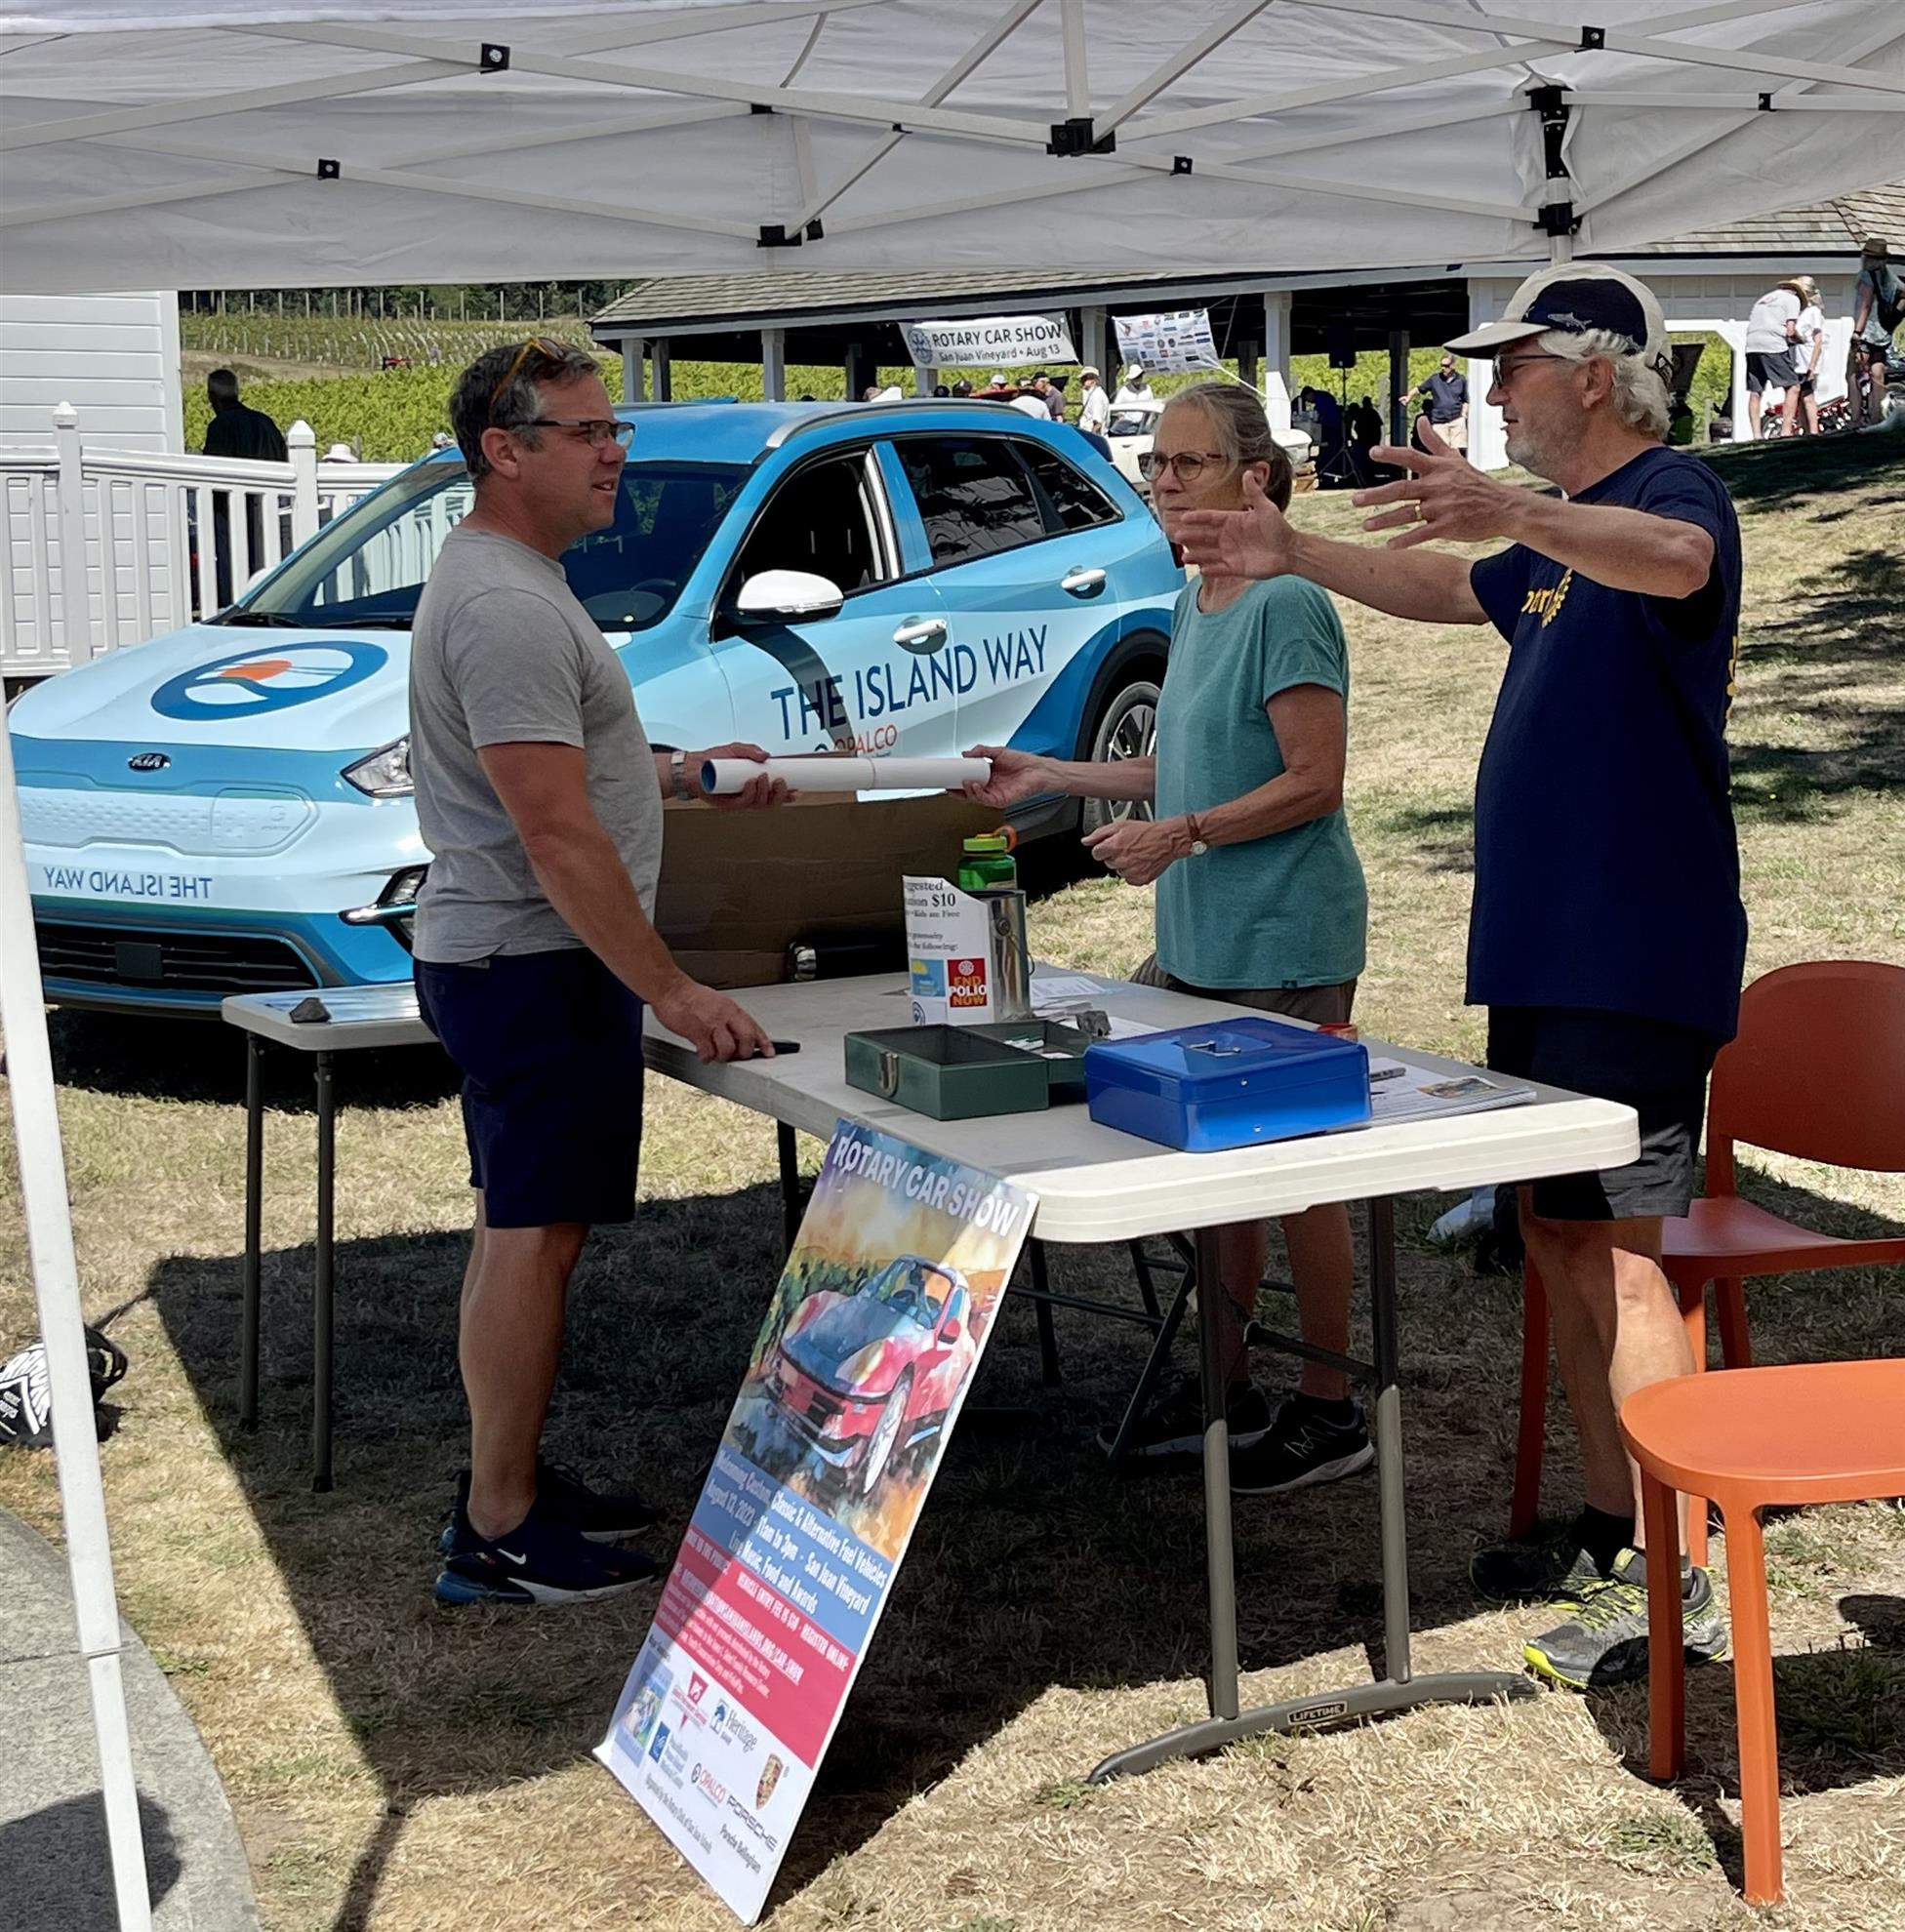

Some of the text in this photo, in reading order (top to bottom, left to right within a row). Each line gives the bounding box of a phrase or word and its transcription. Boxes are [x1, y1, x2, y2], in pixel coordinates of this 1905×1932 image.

[932, 324, 1061, 347] ROTARY CAR SHOW
[939, 343, 1060, 363] San Juan Vineyard Aug 13
[771, 624, 1047, 740] THE ISLAND WAY
[131, 753, 163, 768] KIA
[931, 893, 956, 907] $10
[949, 985, 988, 997] POLIO
[953, 976, 982, 986] END
[952, 995, 986, 1006] NOW
[832, 1135, 1020, 1237] ROTARY CAR SHOW
[799, 1511, 840, 1553] Alternative
[836, 1537, 859, 1565] Fuel
[854, 1549, 887, 1589] Vehicles
[760, 1555, 783, 1585] Food
[776, 1573, 795, 1594] and
[789, 1579, 818, 1614] Awards
[771, 1528, 783, 1550] to
[803, 1551, 821, 1578] San
[816, 1561, 837, 1590] Juan
[834, 1573, 871, 1615] Vineyard
[1293, 1705, 1341, 1721] LIFETIME
[722, 1709, 757, 1753] Heritage
[699, 1768, 726, 1803] OPALCO
[726, 1794, 777, 1851] PORSCHE
[718, 1823, 761, 1874] Porsche Bellingham
